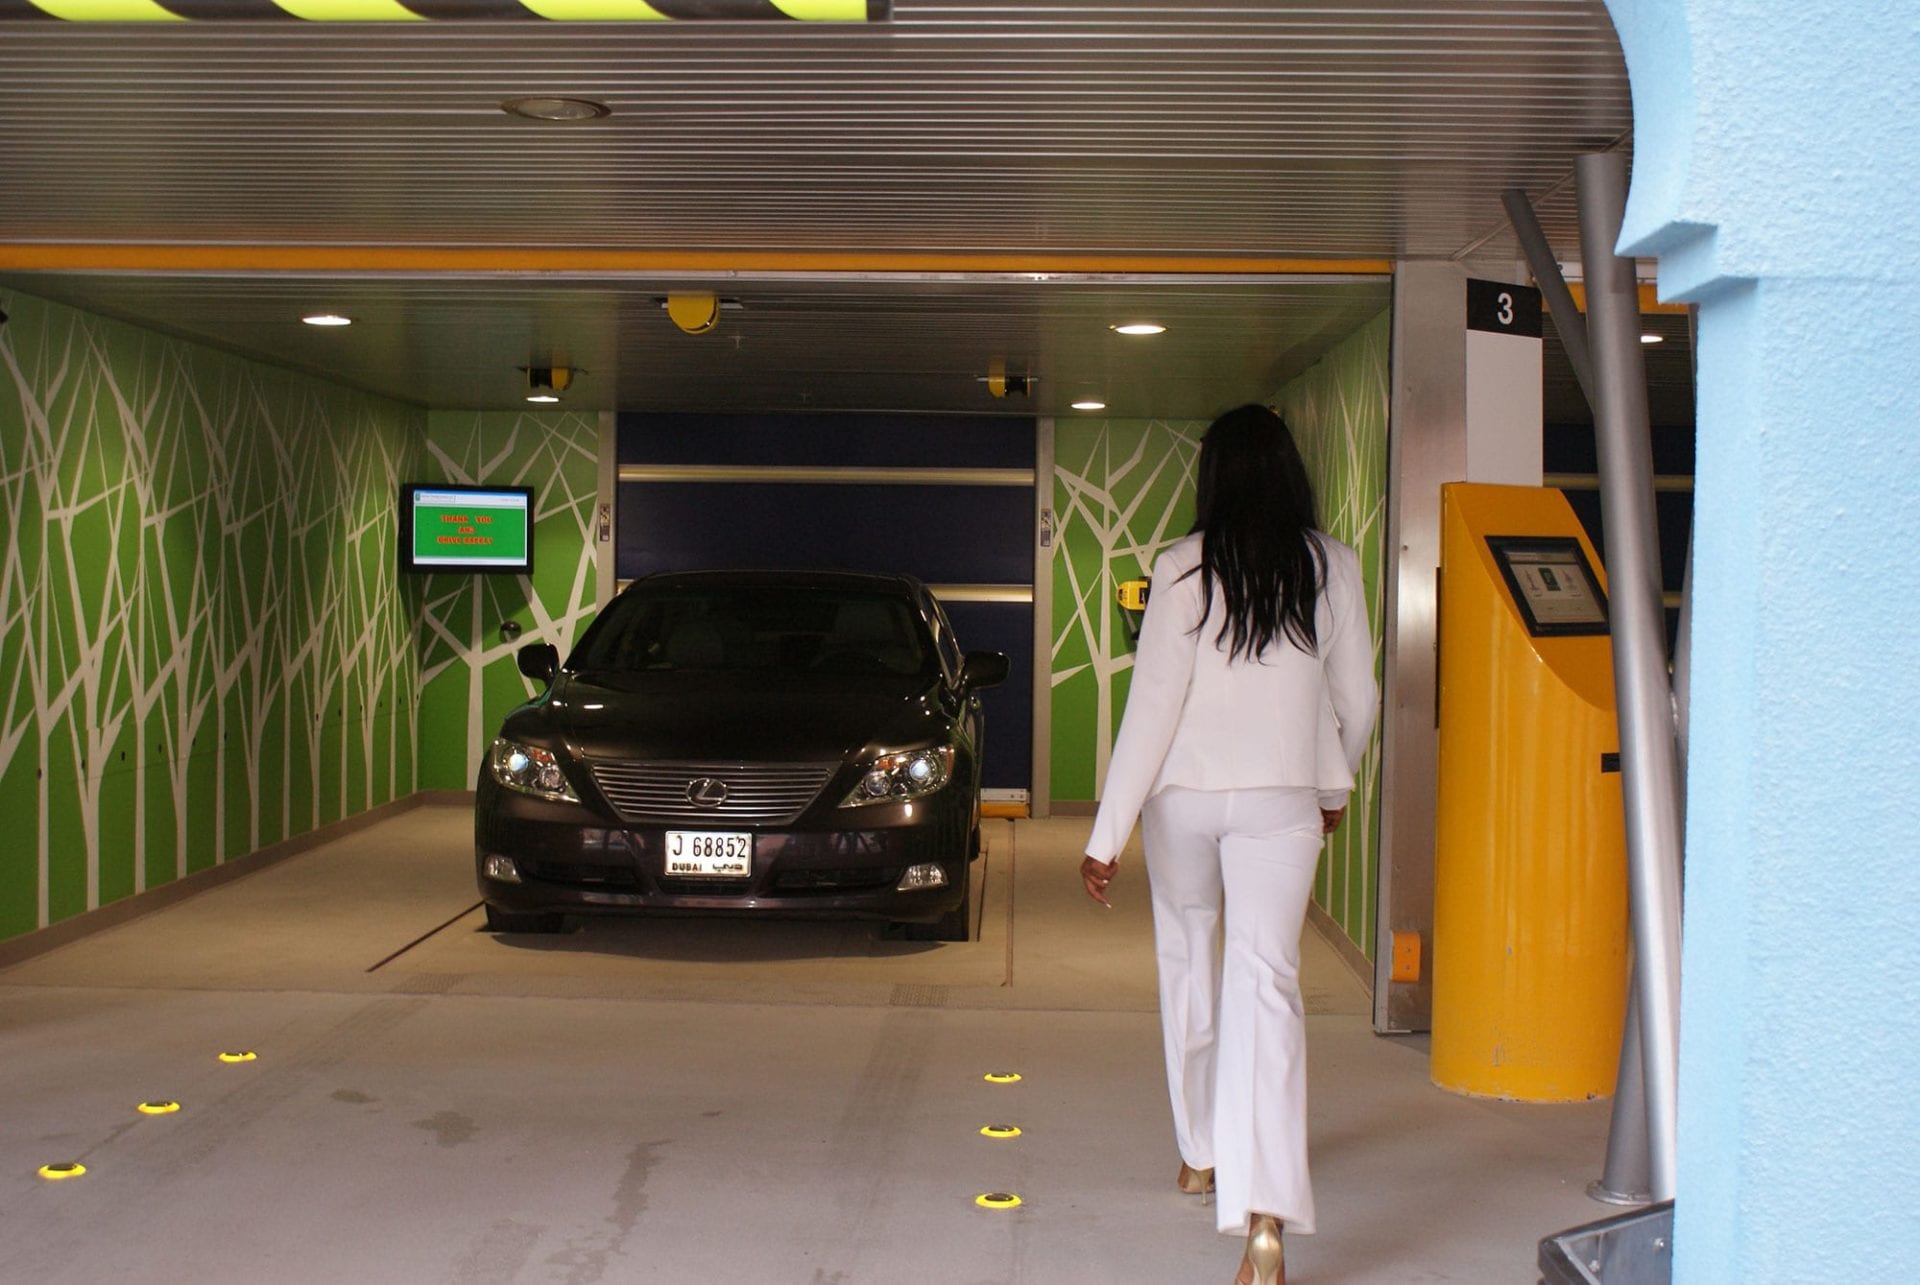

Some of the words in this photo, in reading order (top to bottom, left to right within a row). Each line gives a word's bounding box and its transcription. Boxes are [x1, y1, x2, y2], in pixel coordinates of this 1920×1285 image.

[1497, 292, 1513, 325] 3
[441, 514, 469, 523] THANK
[673, 835, 683, 856] J
[693, 836, 746, 858] 68852
[672, 862, 702, 871] DUBAI
